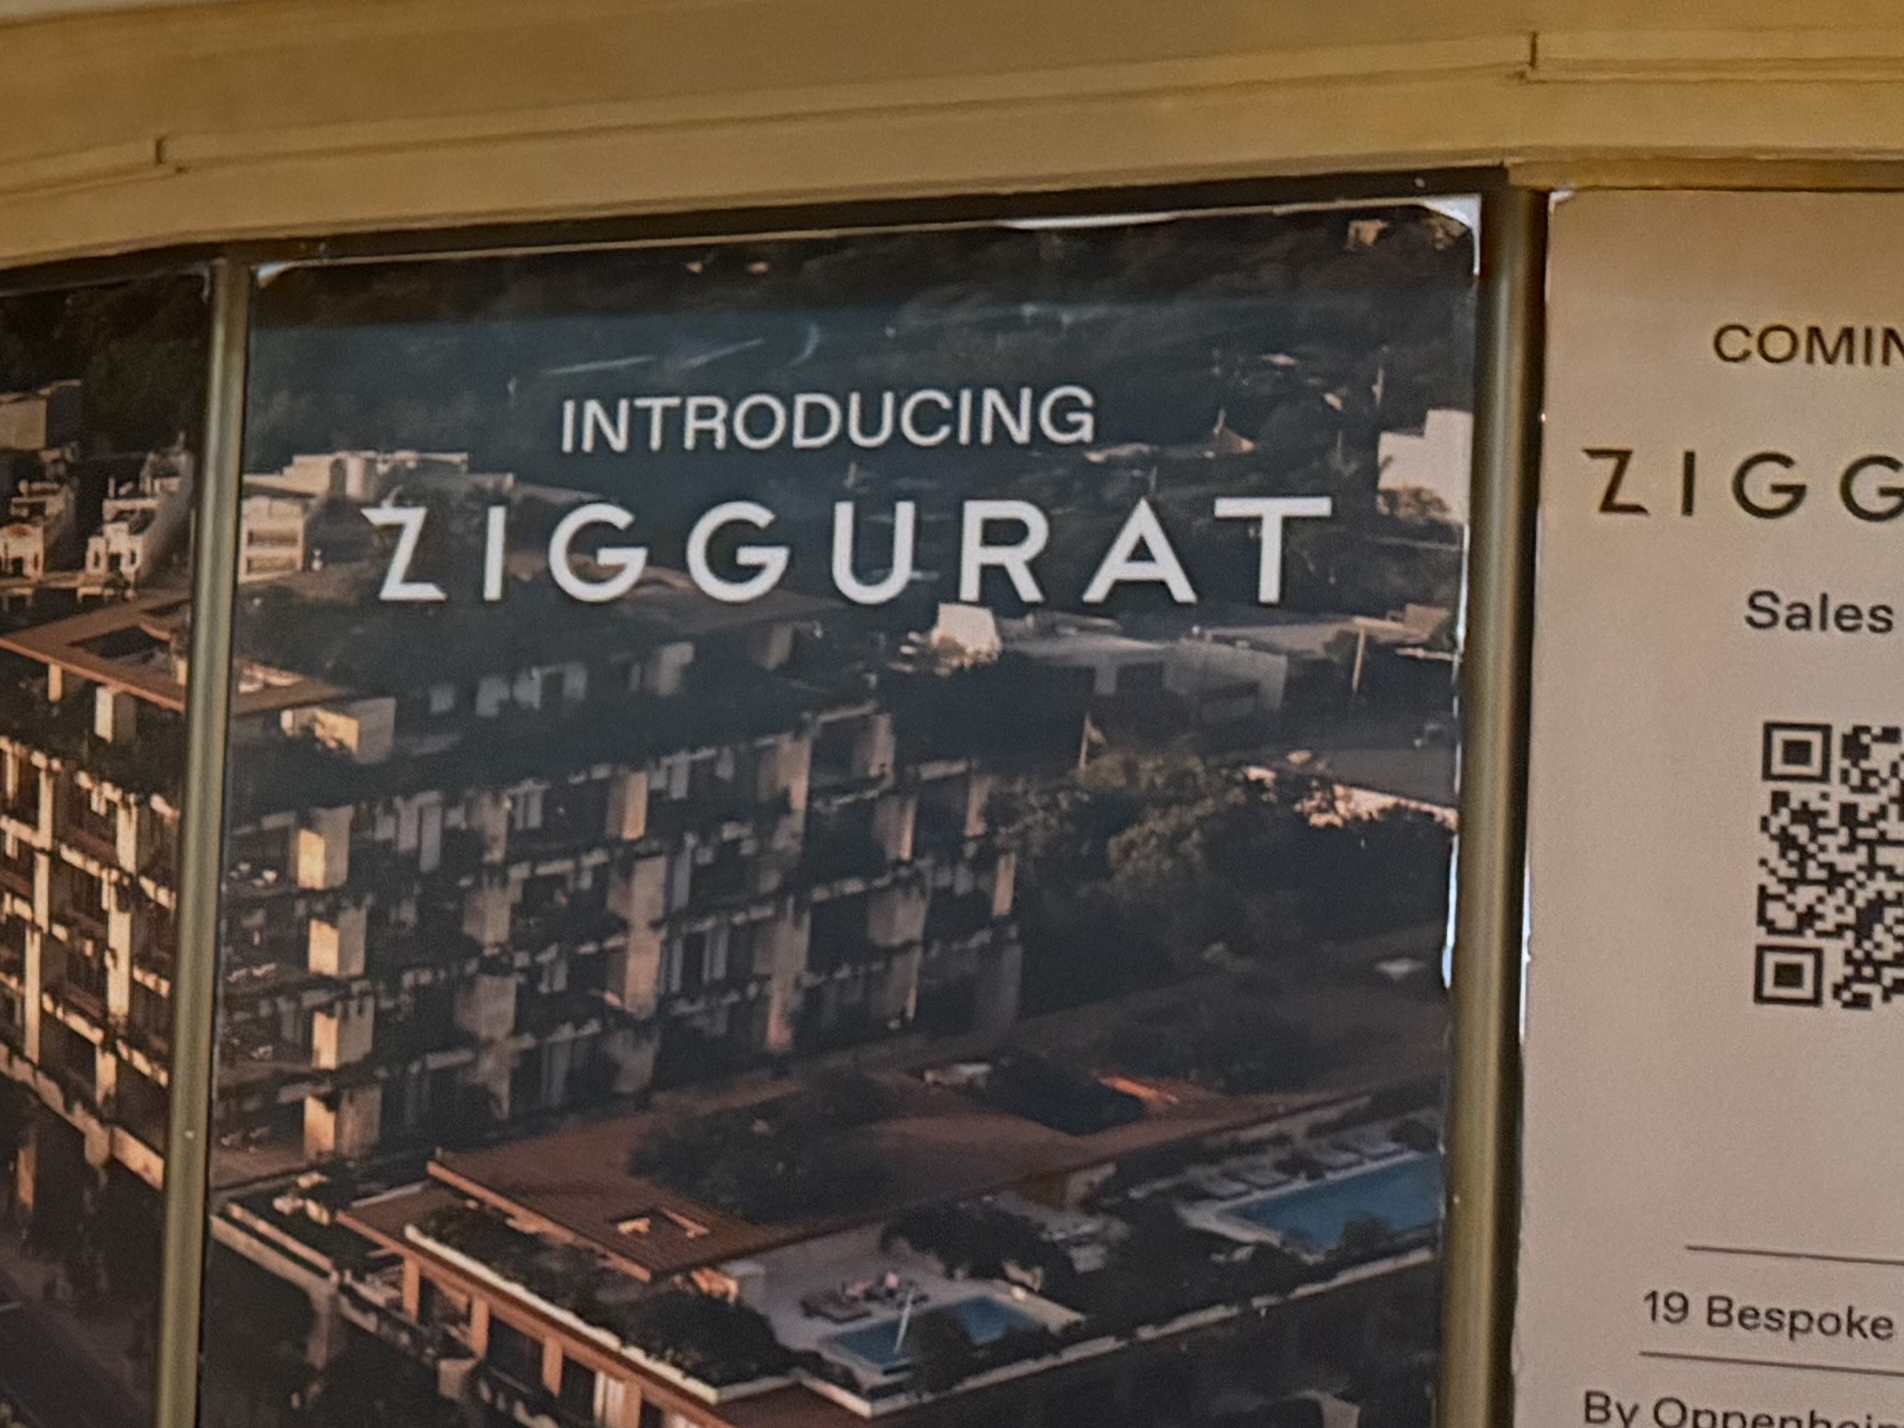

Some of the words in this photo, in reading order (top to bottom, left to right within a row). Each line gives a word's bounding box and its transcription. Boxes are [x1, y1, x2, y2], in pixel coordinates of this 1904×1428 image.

[561, 385, 1095, 453] INTRODUCING
[1581, 447, 1904, 523] ZIGG
[362, 497, 1333, 606] ZIGGURAT
[1744, 589, 1894, 634] Sales
[1643, 1290, 1690, 1324] 19
[1706, 1294, 1894, 1342] Bespoke
